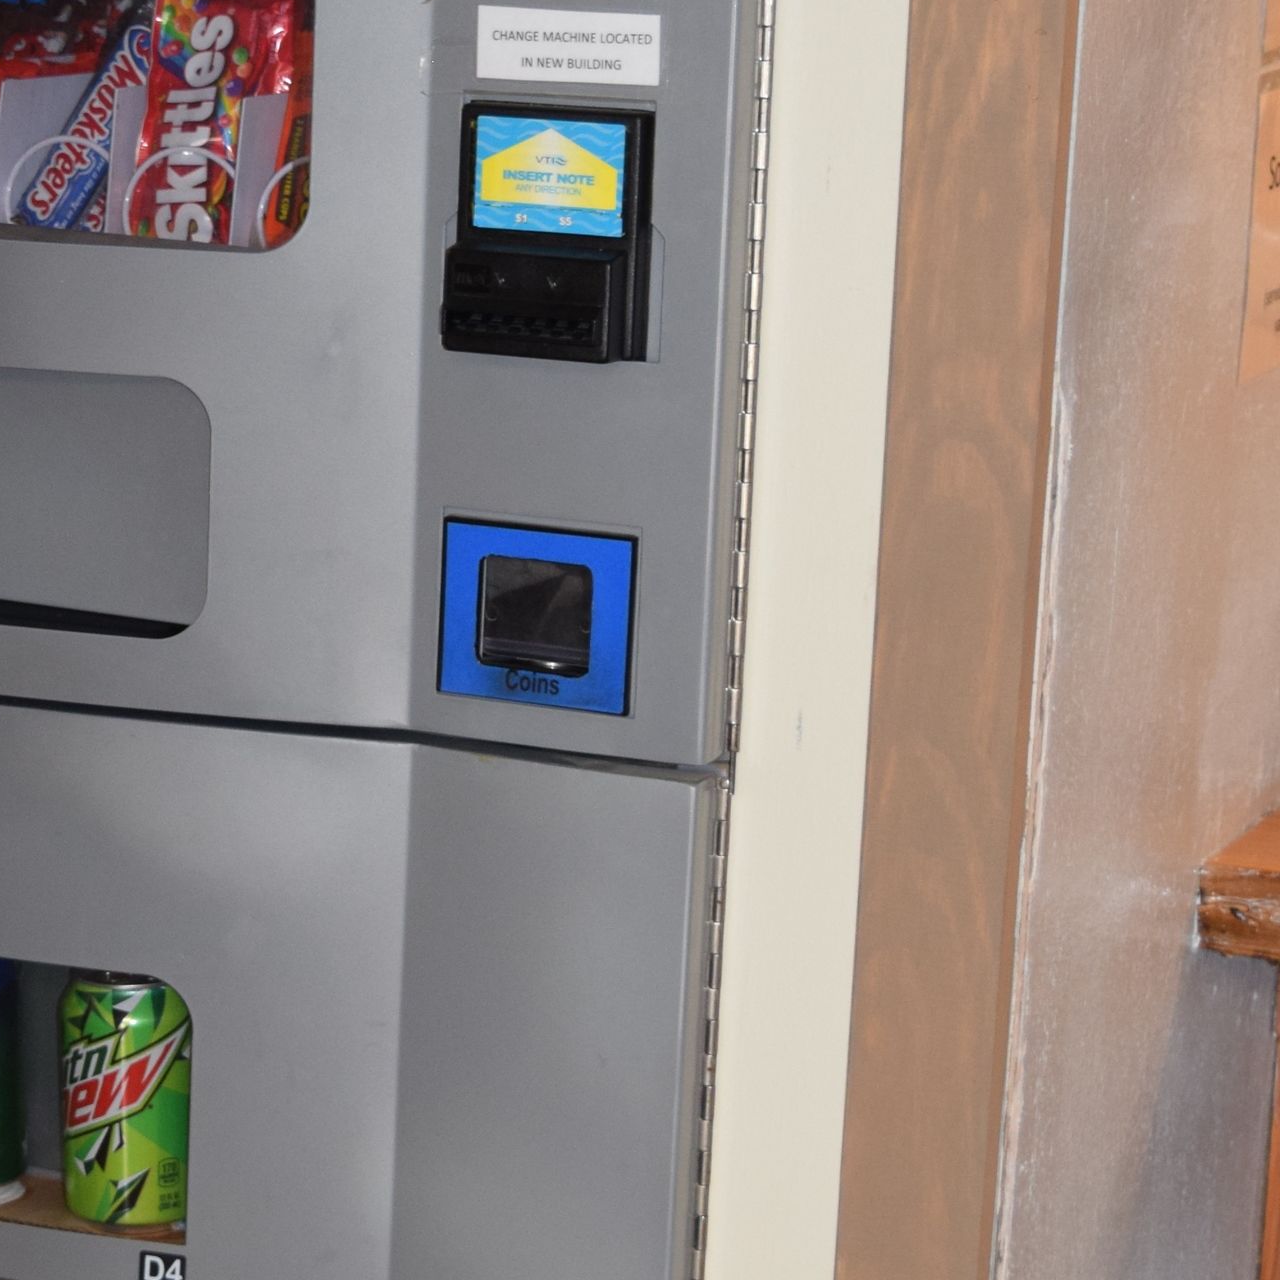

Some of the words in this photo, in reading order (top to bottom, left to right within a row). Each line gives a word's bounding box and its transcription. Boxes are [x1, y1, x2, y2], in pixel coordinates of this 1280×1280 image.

[491, 29, 540, 43] CHANGE
[542, 30, 597, 44] MACHINE
[600, 32, 654, 46] LOCATED
[521, 56, 533, 68] IN
[536, 57, 564, 69] NEW
[567, 57, 623, 71] BUILDING
[503, 169, 555, 184] INSERT
[556, 171, 596, 187] NOTE
[514, 184, 534, 194] ANY
[534, 185, 583, 196] DIRECTION
[504, 669, 561, 696] Coins
